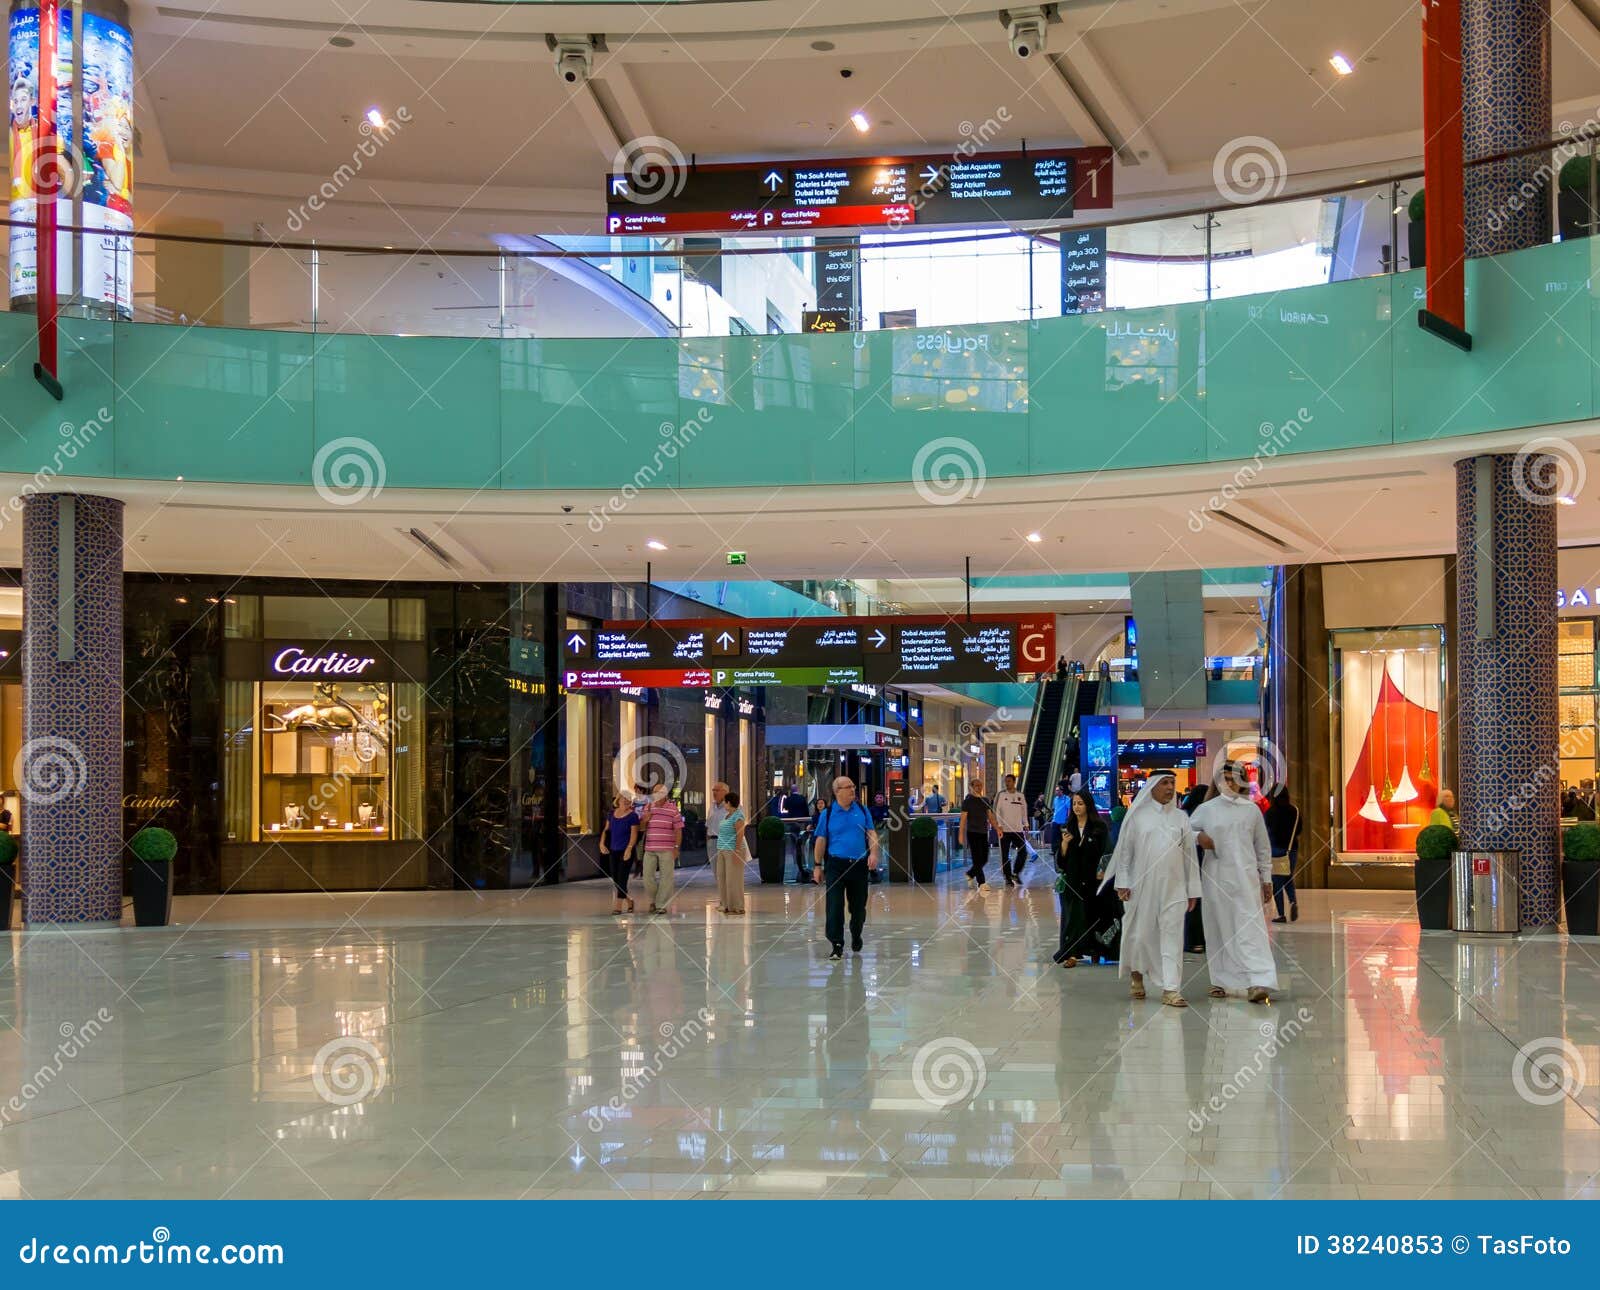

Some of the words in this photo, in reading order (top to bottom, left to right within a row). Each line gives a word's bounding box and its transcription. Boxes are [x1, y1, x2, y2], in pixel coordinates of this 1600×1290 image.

[970, 163, 1001, 171] Aquarium
[820, 180, 850, 188] Lafayette
[1086, 169, 1097, 198] 1
[983, 189, 1011, 197] Fountain
[644, 216, 666, 224] Parking
[764, 212, 773, 225] P
[609, 217, 621, 233] P
[1083, 247, 1099, 255] 300
[1087, 278, 1100, 286] دبي
[919, 629, 946, 637] Aquarium
[611, 642, 625, 650] Souk
[763, 639, 784, 647] Parking
[760, 647, 778, 655] Village
[1022, 634, 1046, 662] G
[622, 651, 650, 659] Lafayette
[274, 648, 375, 674] Cartier
[600, 671, 621, 679] Parking
[716, 671, 726, 684] P
[567, 672, 577, 687] P
[122, 794, 179, 808] Cartier
